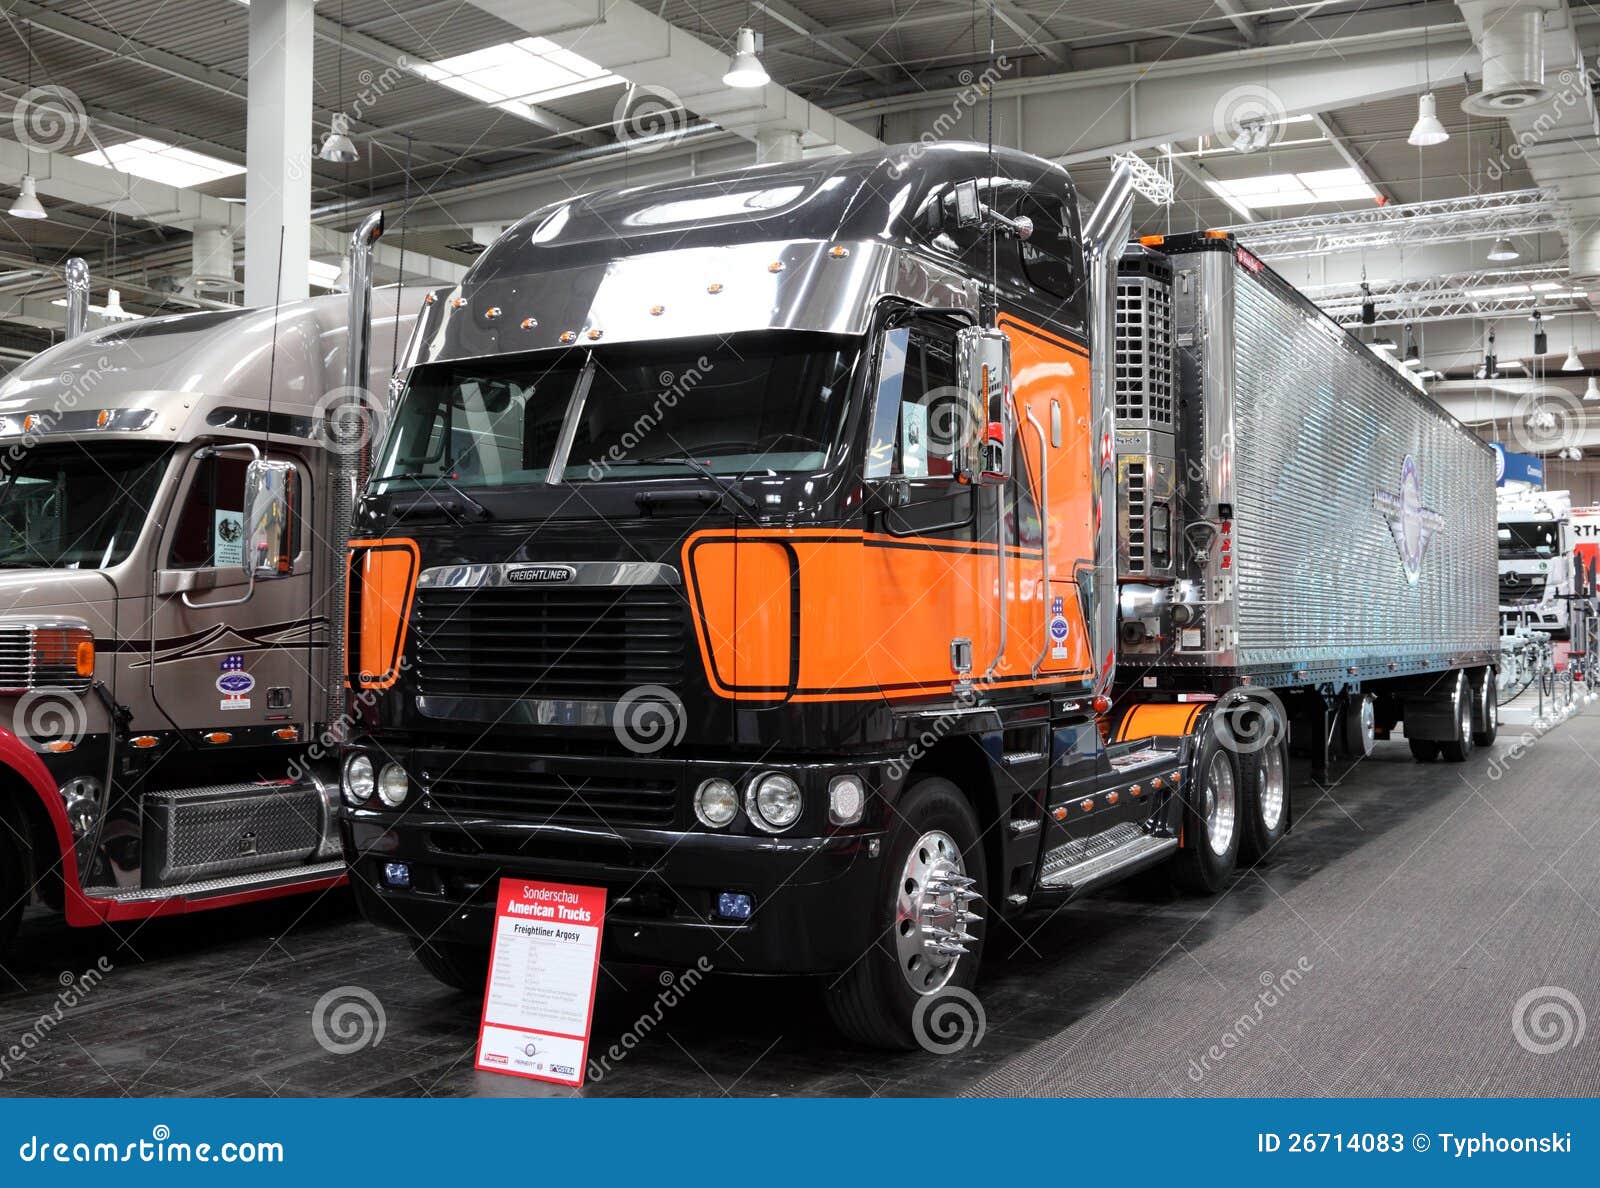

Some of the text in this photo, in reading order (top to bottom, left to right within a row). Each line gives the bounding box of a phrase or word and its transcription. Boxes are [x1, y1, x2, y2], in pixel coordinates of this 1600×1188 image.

[509, 569, 568, 581] FREIGHTLINER
[523, 885, 579, 904] Sonderschau
[507, 899, 592, 922] American Trucks
[514, 923, 581, 942] Freightliner Argosy
